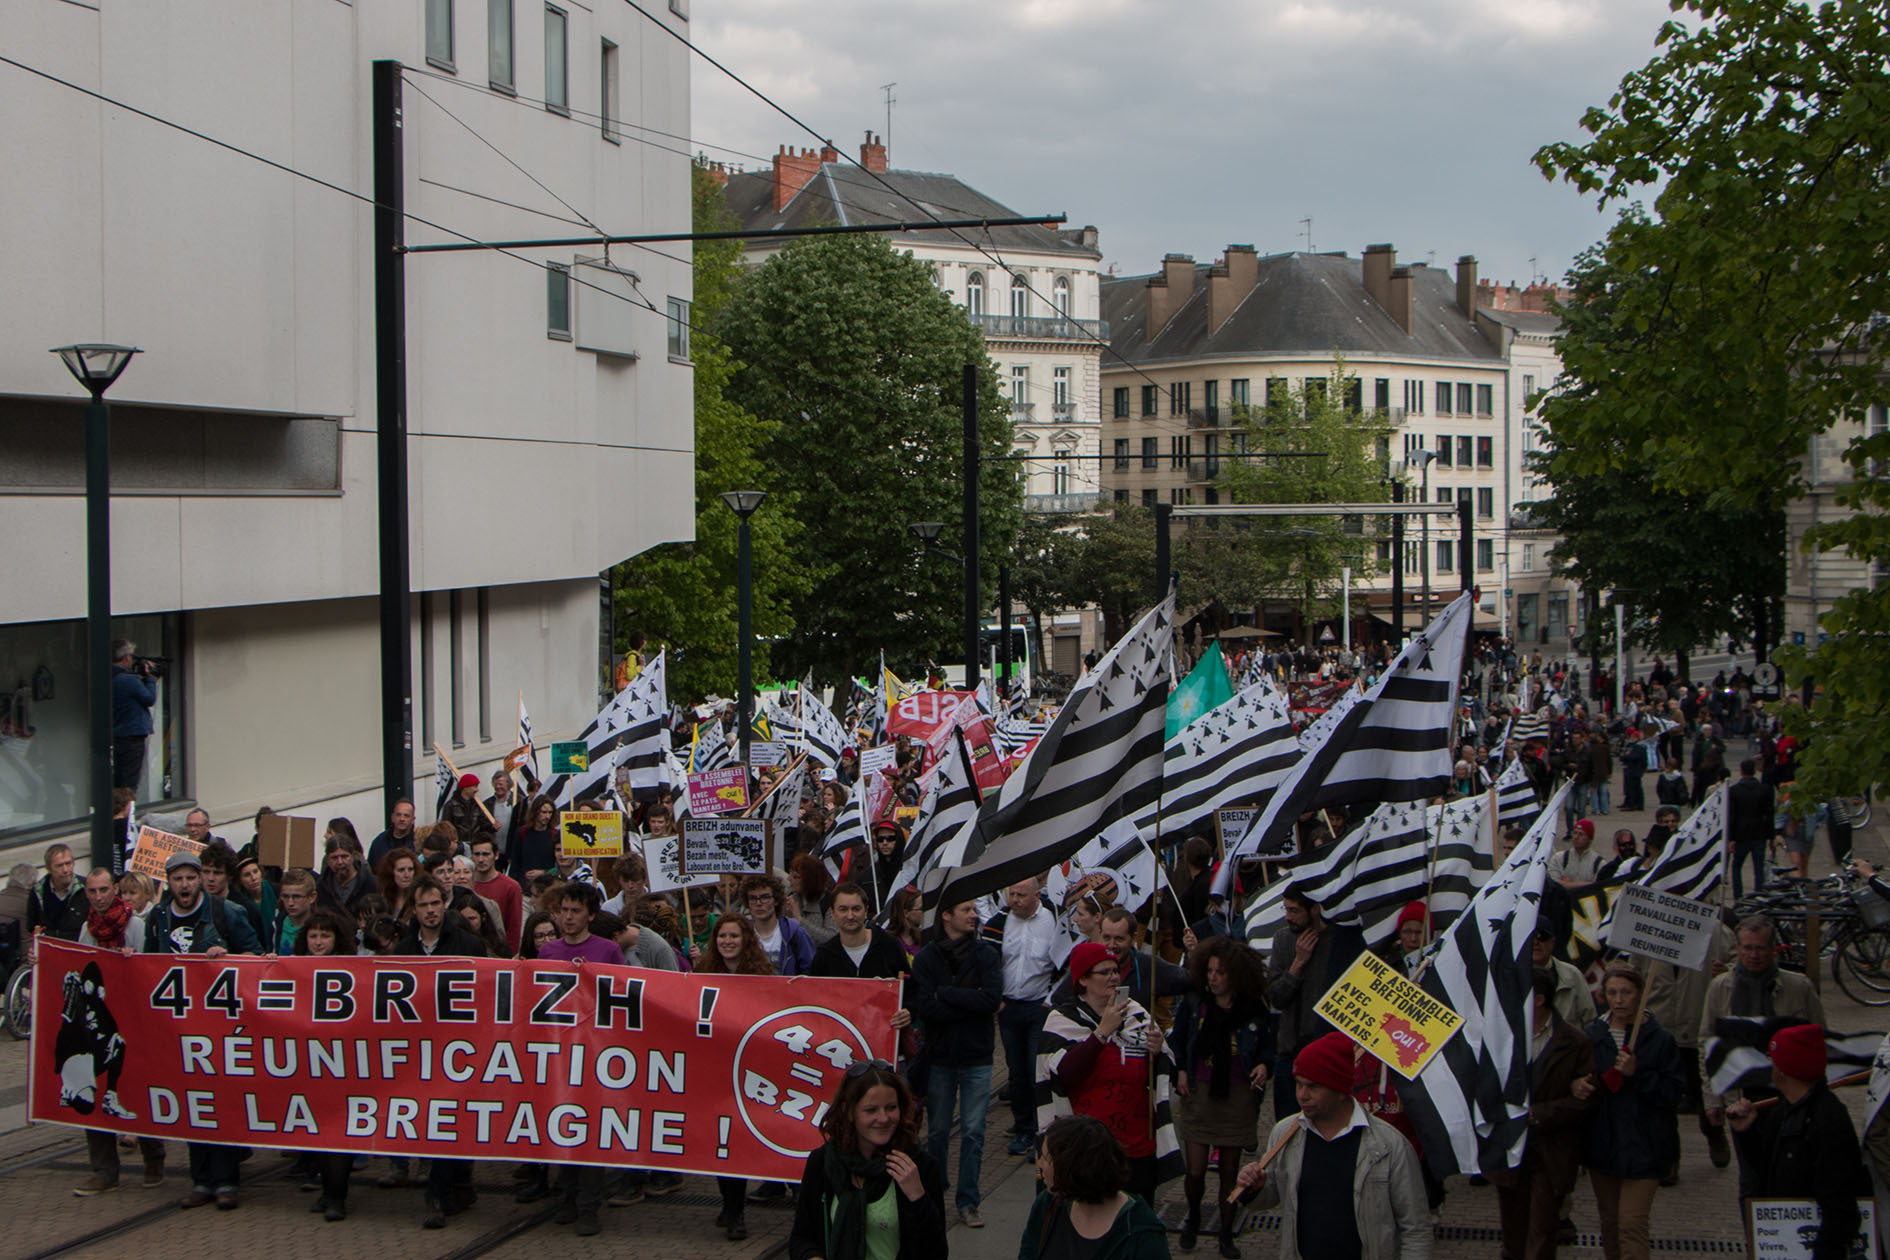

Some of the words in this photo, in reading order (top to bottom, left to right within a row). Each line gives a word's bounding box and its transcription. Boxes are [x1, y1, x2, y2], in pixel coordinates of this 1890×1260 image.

[692, 791, 709, 799] AVEC
[701, 797, 718, 805] PAYS
[685, 821, 718, 832] BREIZH
[720, 821, 764, 832] adunvanet
[1221, 811, 1250, 822] BREIZH
[135, 855, 144, 863] LE
[138, 847, 157, 858] AVEC
[1658, 895, 1699, 915] DECIDER
[1701, 907, 1714, 918] ET
[1629, 904, 1686, 927] TRAVAILLER
[1687, 920, 1702, 931] EN
[1634, 922, 1686, 944] BRETAGNE
[1630, 938, 1681, 959] REUNIFIEE
[1340, 982, 1371, 1007] AVEC
[1362, 956, 1389, 979] UNE
[1387, 976, 1458, 1028] ASSEMBLEE
[1369, 978, 1433, 1027] BRETONNE
[1330, 991, 1347, 1006] LE
[1344, 1001, 1376, 1027] PAYS
[1321, 1002, 1371, 1041] NANTAIS
[1392, 1030, 1416, 1049] OUI
[180, 1026, 687, 1095] RÉUNIFICATION
[148, 1086, 219, 1130] DE
[244, 1092, 320, 1135] LA
[345, 1096, 687, 1156] BRETAGNE
[1756, 1207, 1812, 1220] BRETAGNE
[1757, 1227, 1779, 1236] Pour
